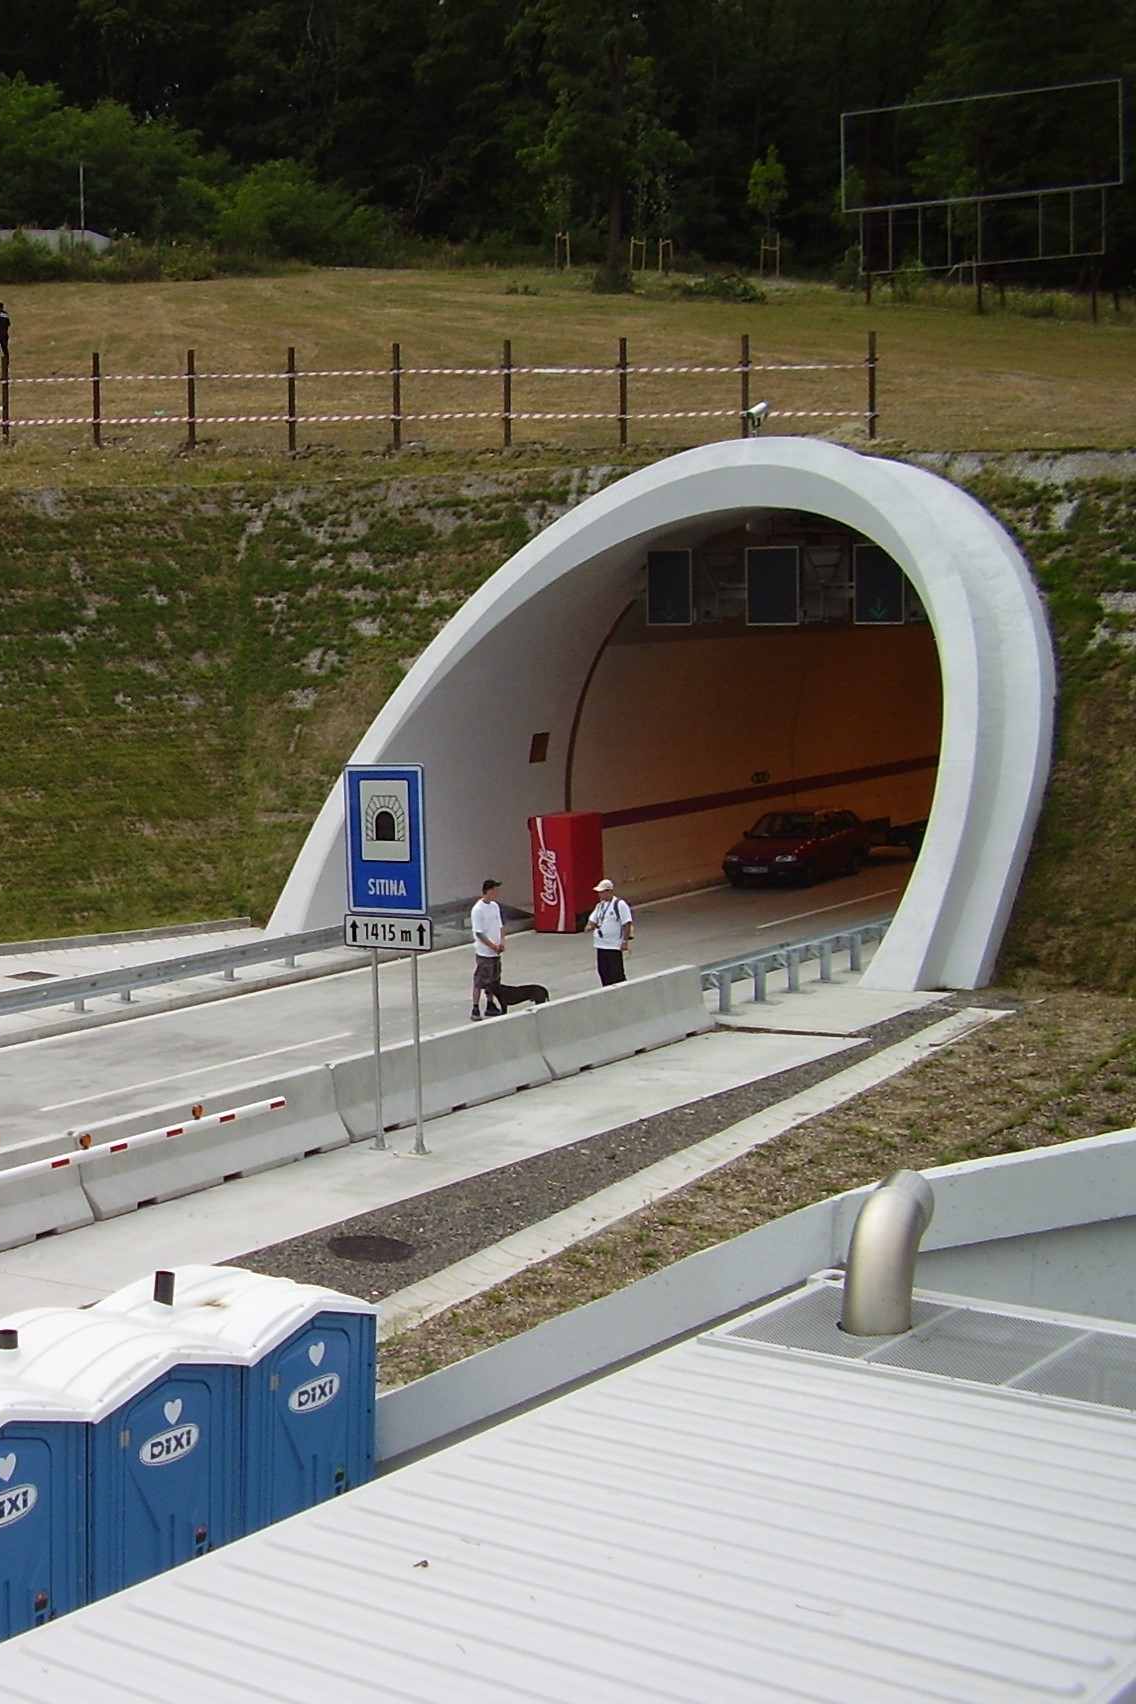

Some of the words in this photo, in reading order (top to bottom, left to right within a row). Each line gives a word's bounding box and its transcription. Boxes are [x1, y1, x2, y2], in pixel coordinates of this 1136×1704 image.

[367, 878, 407, 896] SITINA
[363, 922, 396, 942] 1415
[400, 929, 412, 942] m
